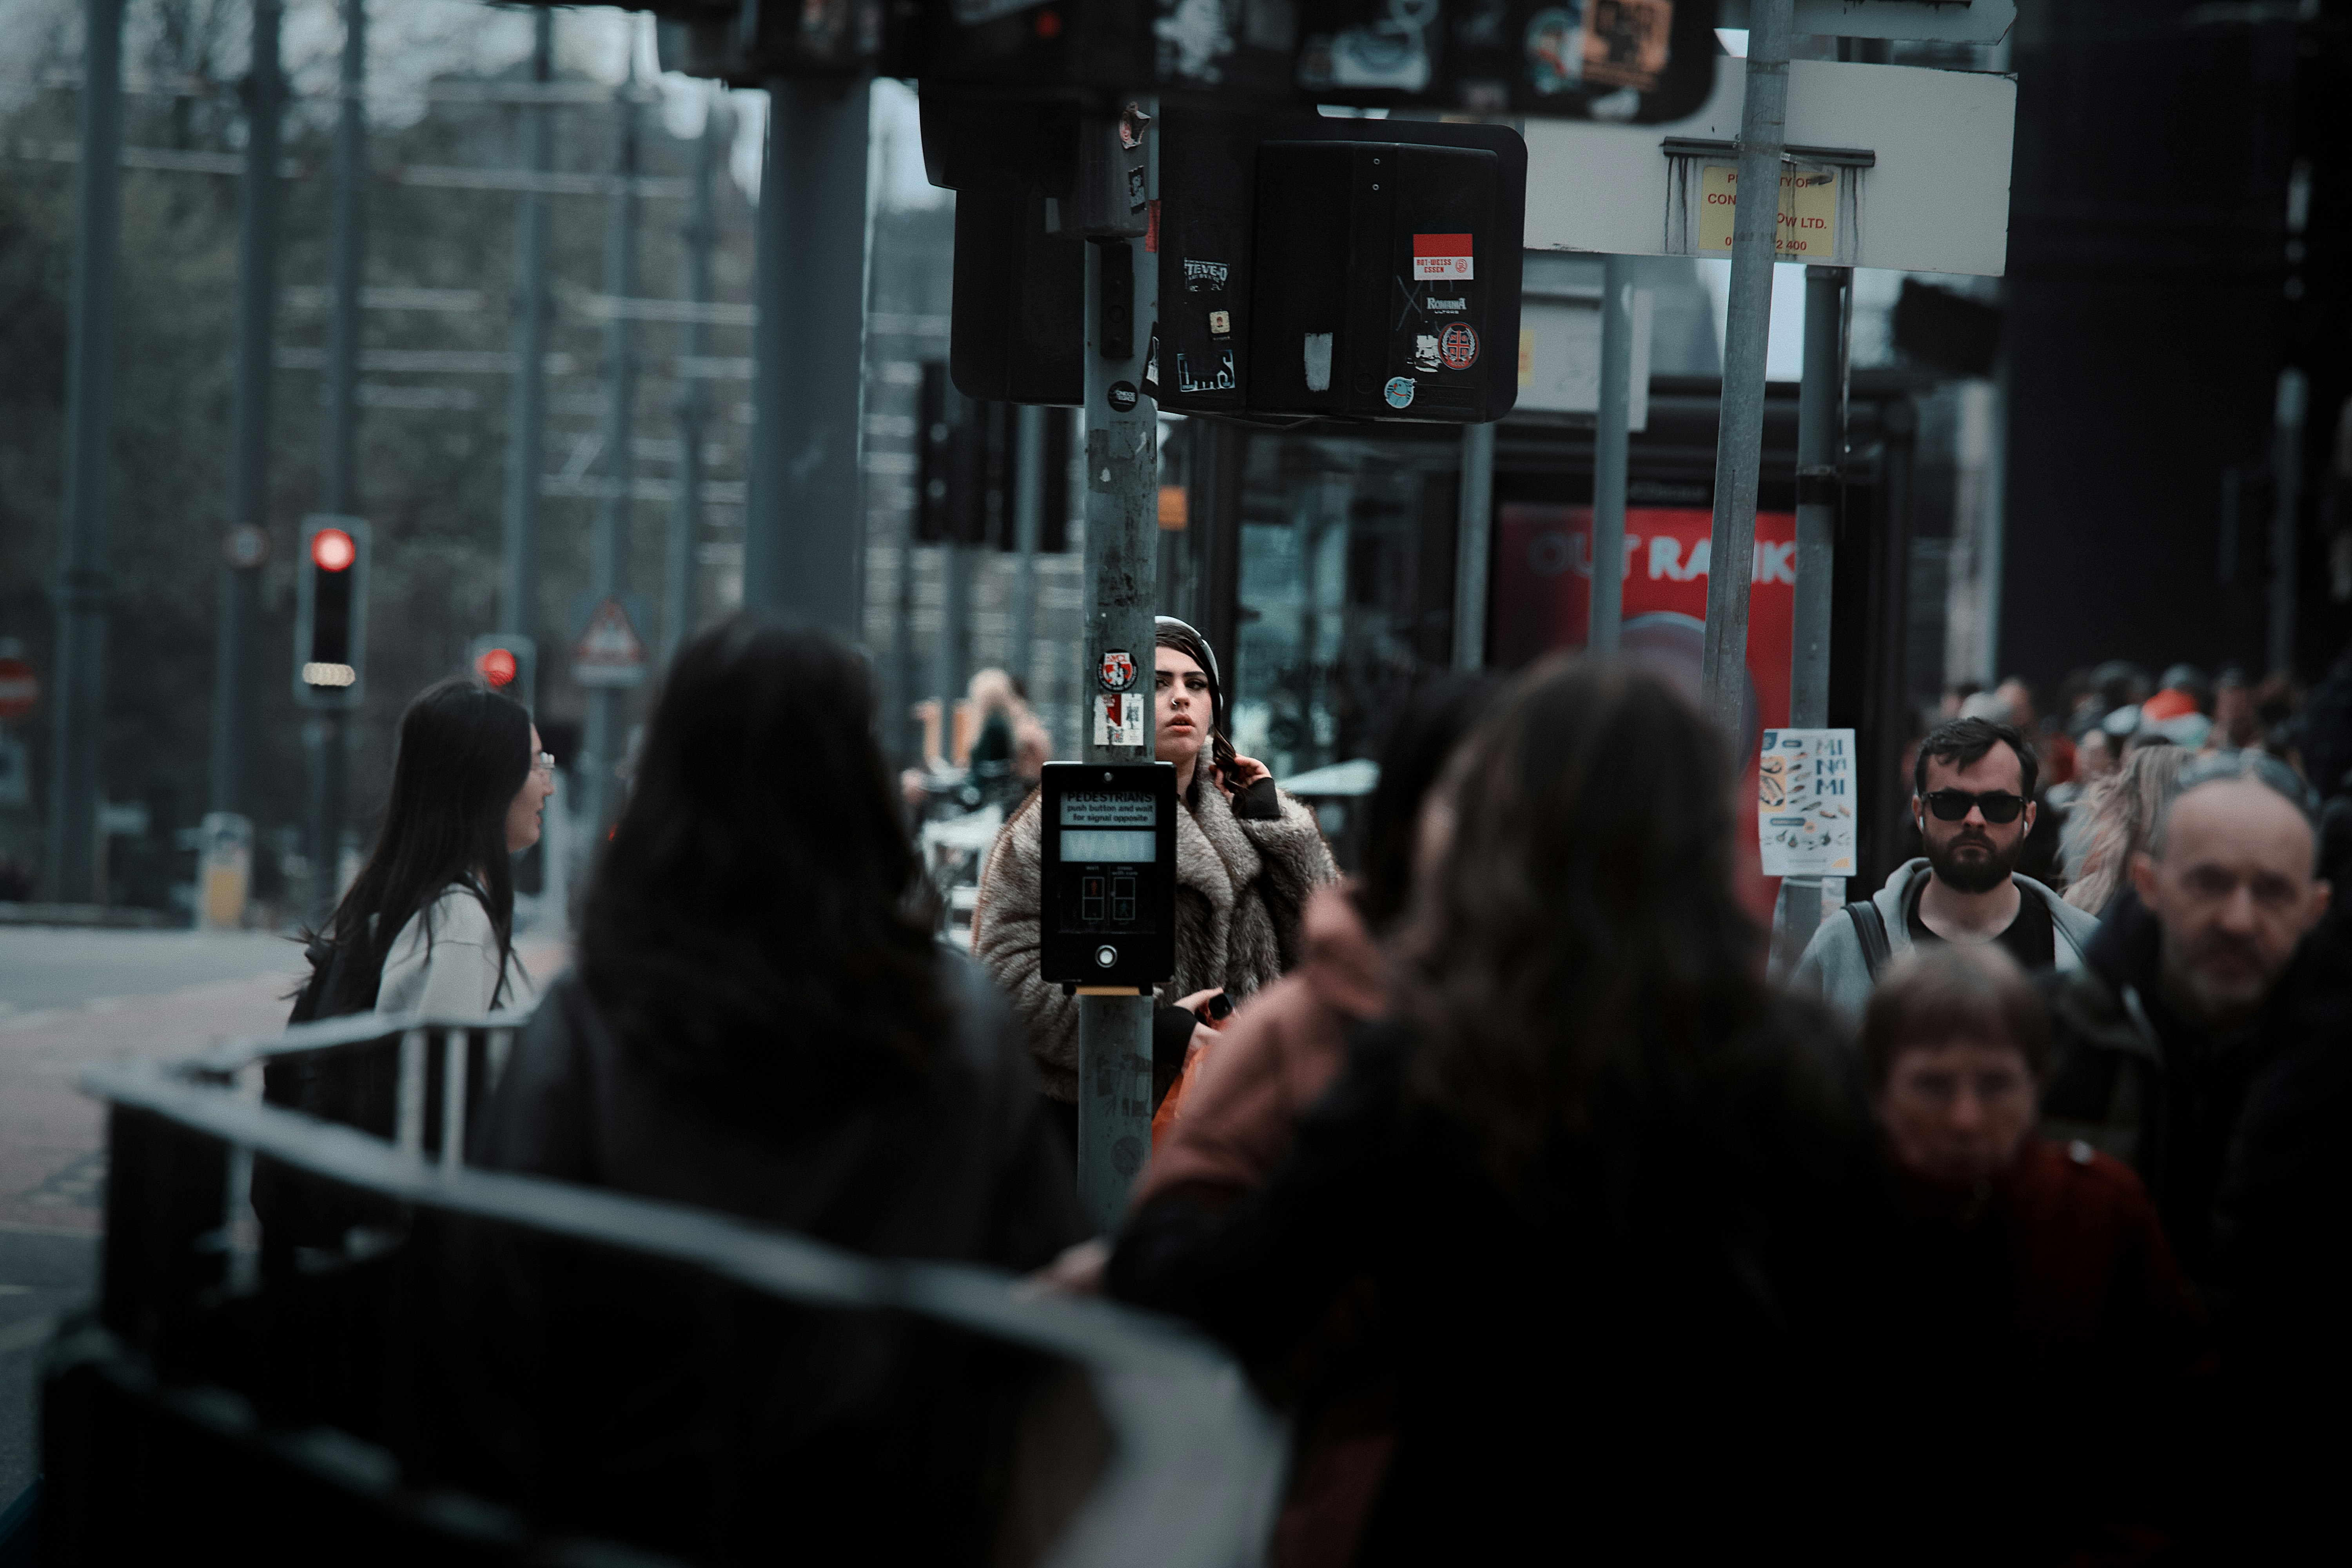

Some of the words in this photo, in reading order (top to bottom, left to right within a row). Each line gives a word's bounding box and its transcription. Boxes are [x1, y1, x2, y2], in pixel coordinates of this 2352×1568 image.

[1801, 218, 1827, 229] LTD.
[1786, 240, 1807, 250] 400
[1648, 535, 1796, 584] RAK
[1816, 779, 1845, 795] MI
[1067, 791, 1152, 802] PEDESTRIANS
[1087, 814, 1112, 822] signal
[1113, 814, 1148, 822] opposite
